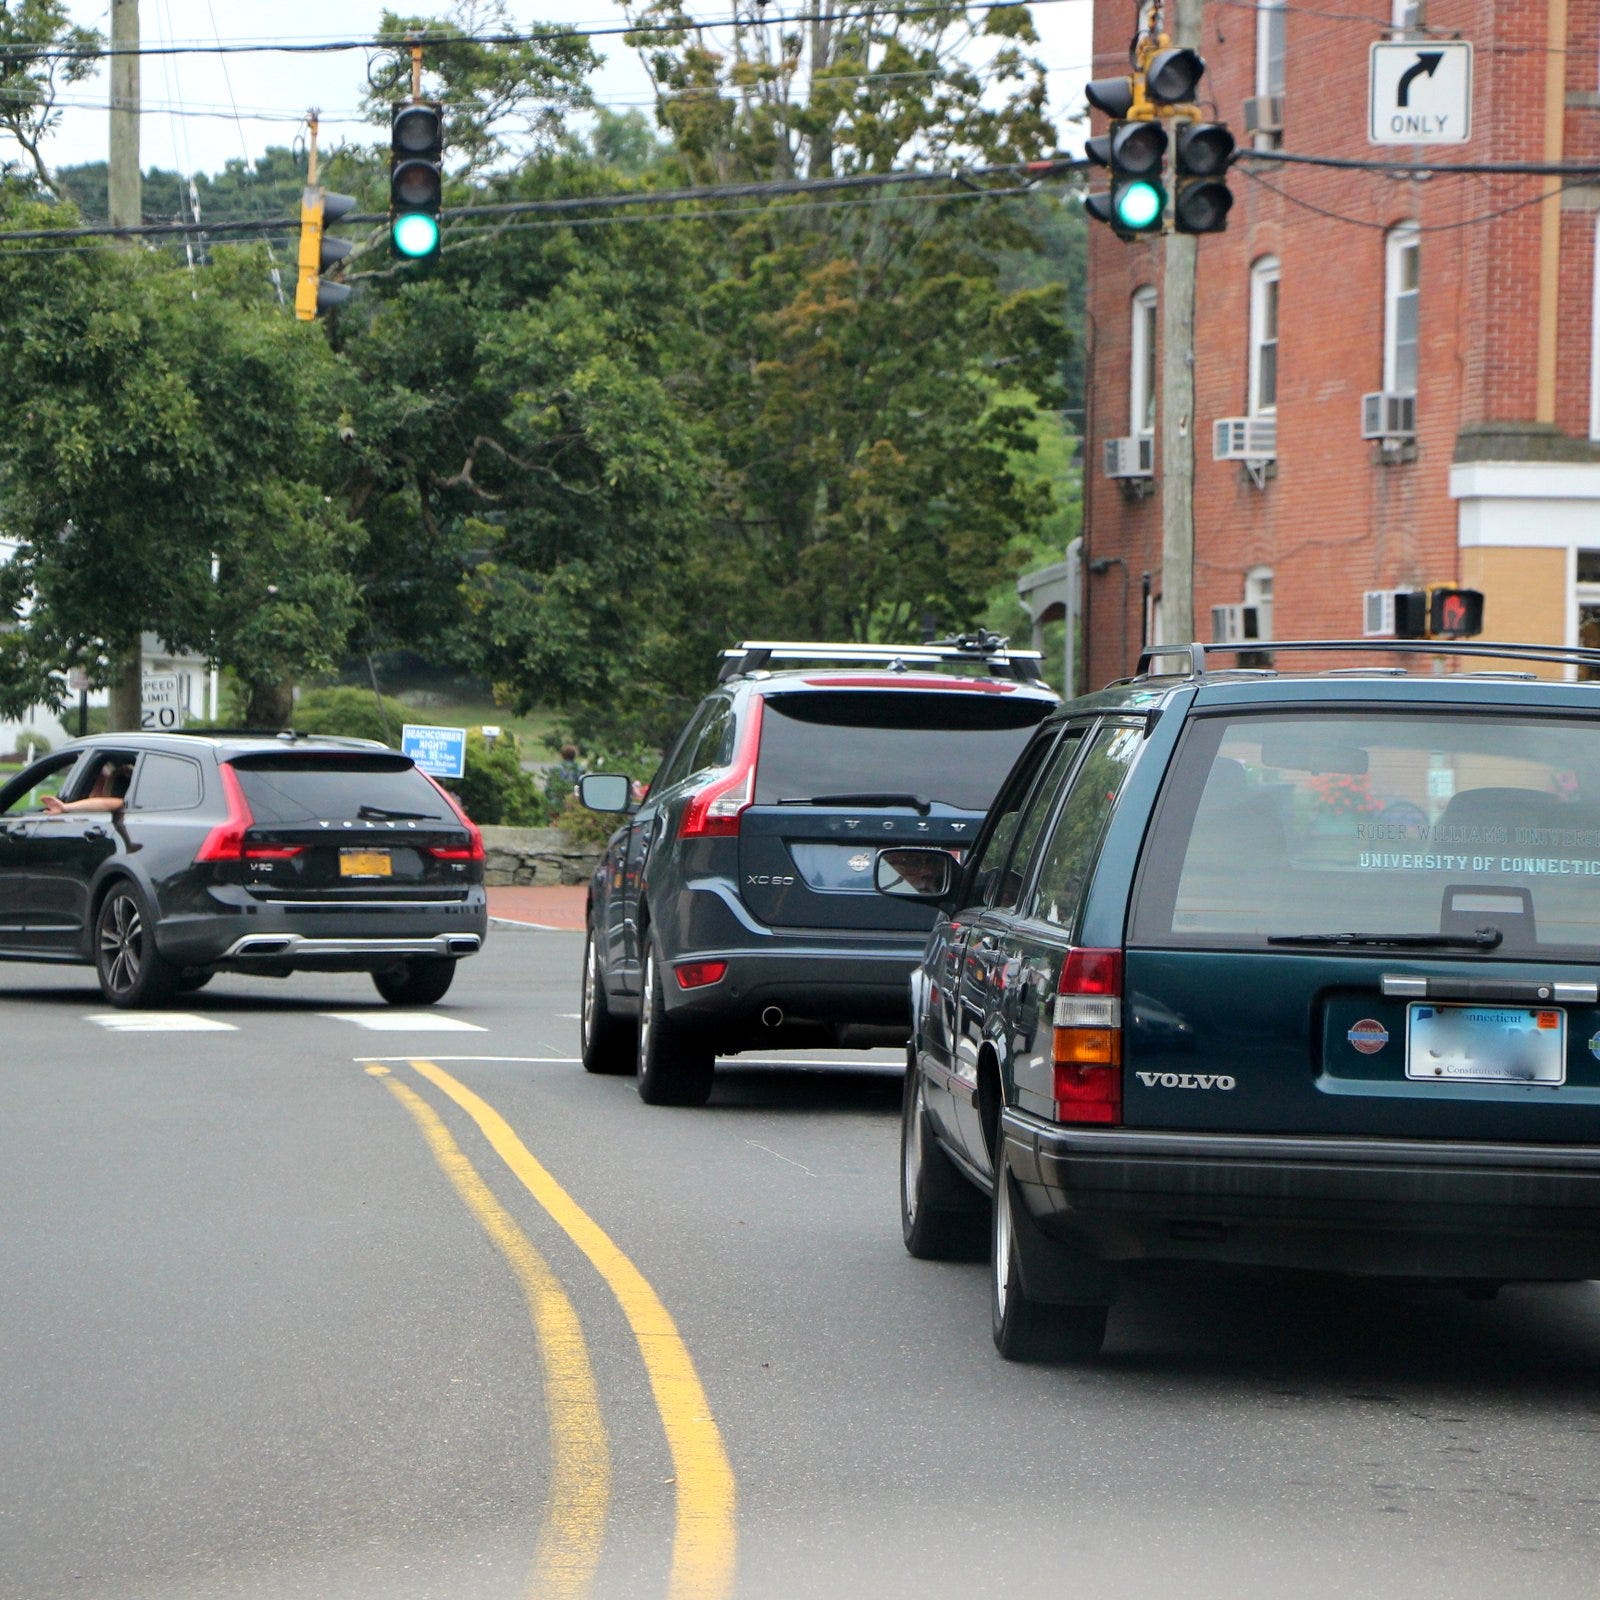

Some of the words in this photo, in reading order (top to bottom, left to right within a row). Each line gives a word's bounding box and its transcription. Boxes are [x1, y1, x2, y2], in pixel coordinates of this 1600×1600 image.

[1391, 115, 1449, 133] ONLY
[143, 680, 174, 690] PEED
[141, 709, 175, 728] 20
[844, 820, 966, 832] VOLV
[1356, 823, 1406, 840] ROGER
[1417, 824, 1506, 845] WILLIAMS
[1360, 852, 1468, 870] UNIVERSITY
[1473, 856, 1495, 871] OF
[747, 875, 794, 885] XC60
[1446, 1065, 1501, 1077] Constitution
[1136, 1071, 1236, 1091] VOLVO
